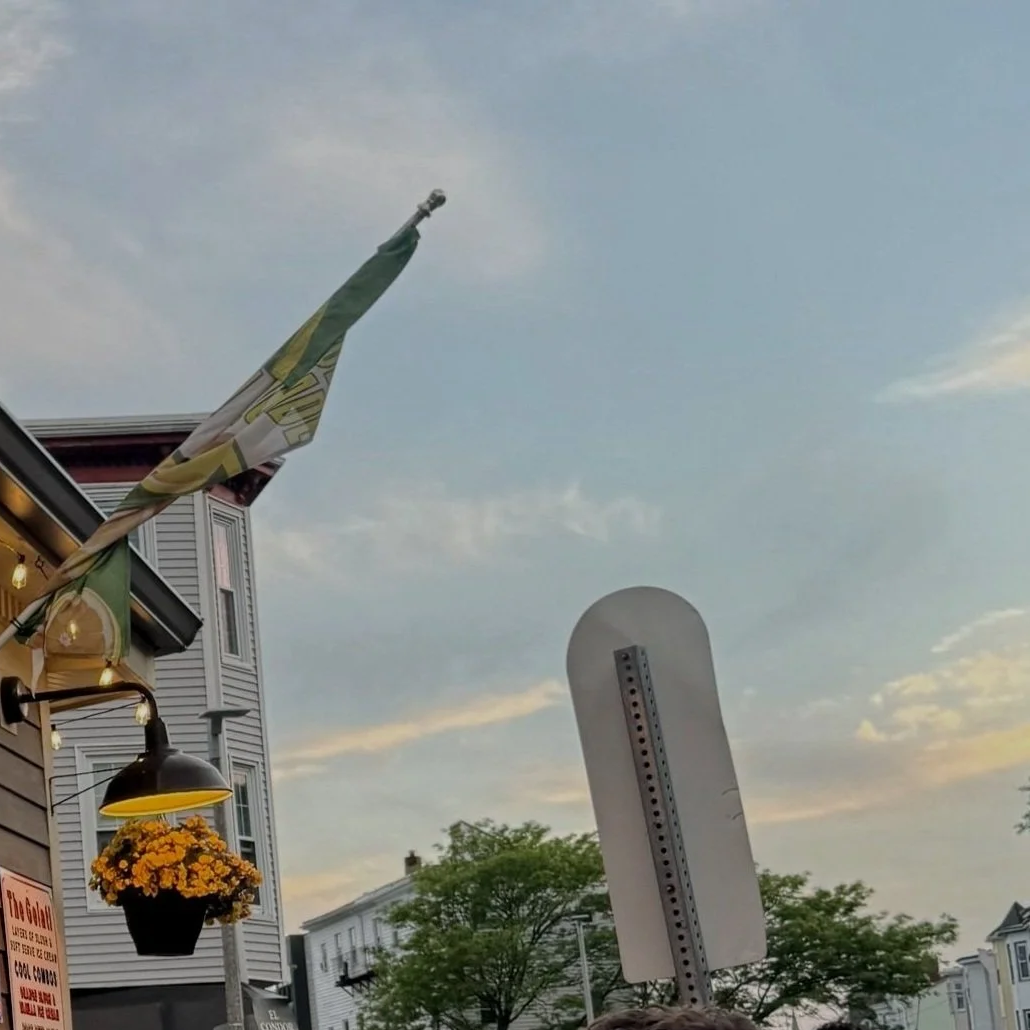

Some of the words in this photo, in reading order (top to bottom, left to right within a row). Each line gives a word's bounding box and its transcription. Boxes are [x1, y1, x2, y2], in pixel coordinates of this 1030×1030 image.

[7, 891, 24, 922] The
[15, 960, 31, 980] COOL
[33, 966, 57, 987] COMBOS
[268, 1010, 278, 1020] EL
